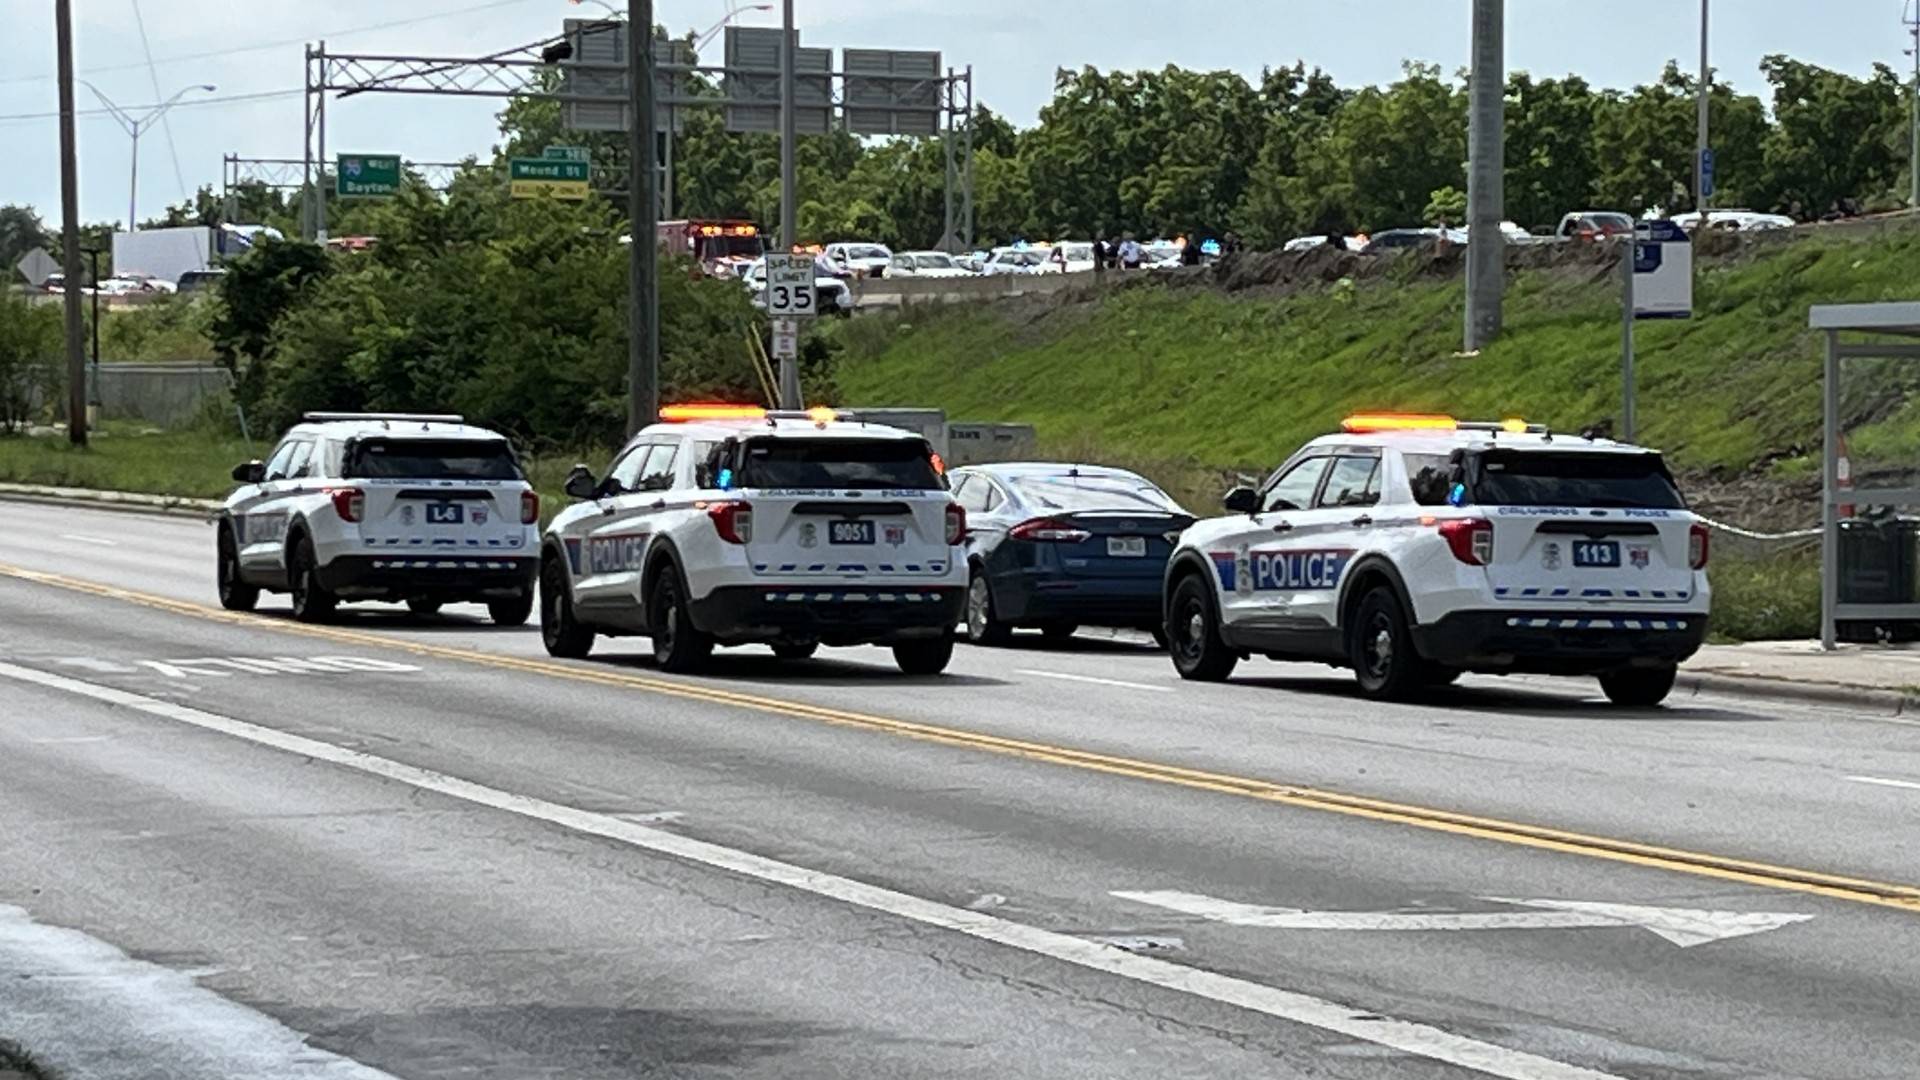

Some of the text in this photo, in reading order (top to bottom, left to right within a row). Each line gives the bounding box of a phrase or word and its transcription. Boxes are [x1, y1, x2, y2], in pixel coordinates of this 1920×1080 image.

[519, 165, 580, 176] Mound St
[346, 181, 392, 194] Dayton
[769, 258, 812, 269] SPEED
[774, 272, 807, 282] LIMIT
[773, 286, 811, 309] 35
[834, 523, 869, 541] 9051
[593, 537, 642, 571] POLICE
[1578, 545, 1613, 563] 113
[1257, 552, 1338, 588] POLICE
